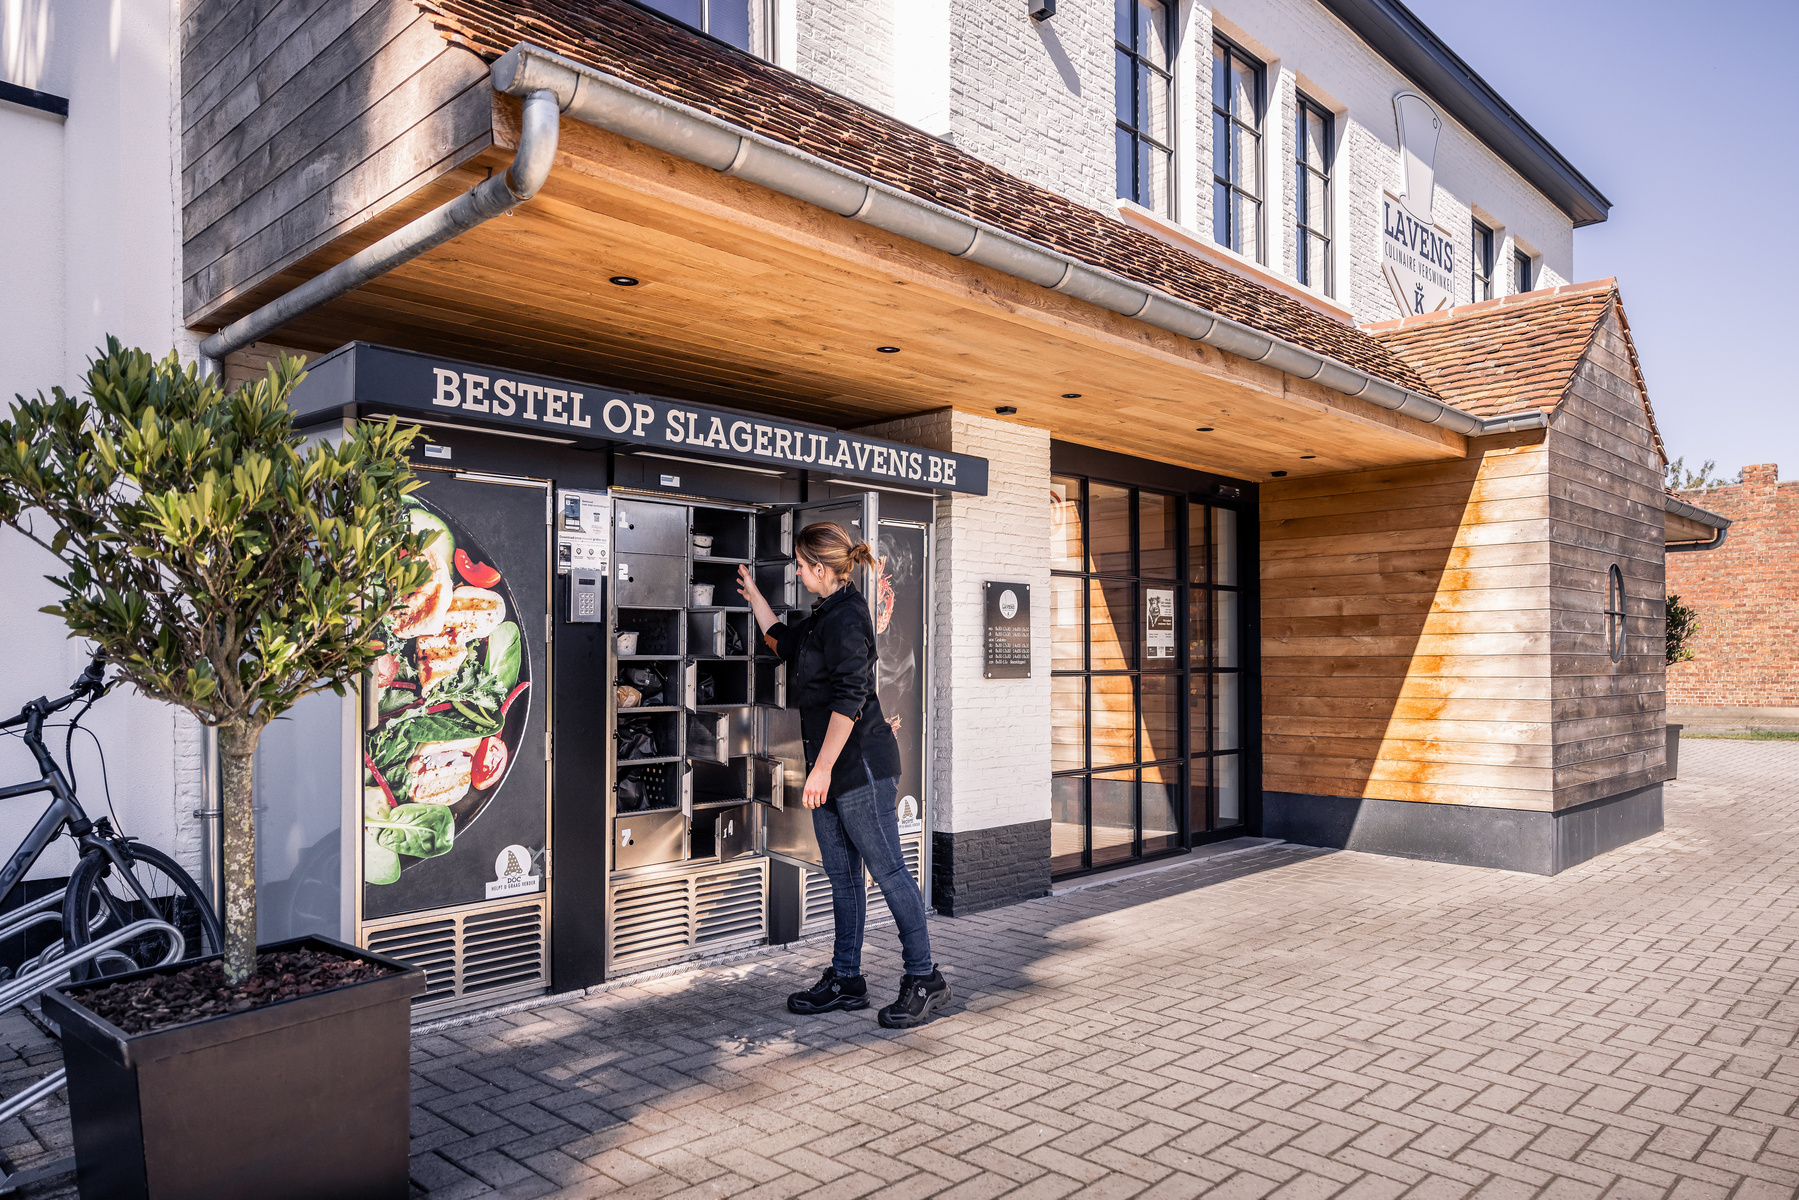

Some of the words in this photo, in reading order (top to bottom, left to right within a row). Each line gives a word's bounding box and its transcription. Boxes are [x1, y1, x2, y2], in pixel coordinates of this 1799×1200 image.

[1384, 201, 1453, 274] LAVENS
[1385, 242, 1416, 272] CULINAIRE
[1418, 260, 1453, 294] VERSWINKEL
[433, 367, 591, 429] BESTEL
[603, 399, 655, 437] OP
[666, 410, 957, 486] SLAGERIJLAVENS.BE
[619, 512, 628, 528] 1
[618, 564, 628, 580] 2
[622, 829, 631, 847] 7
